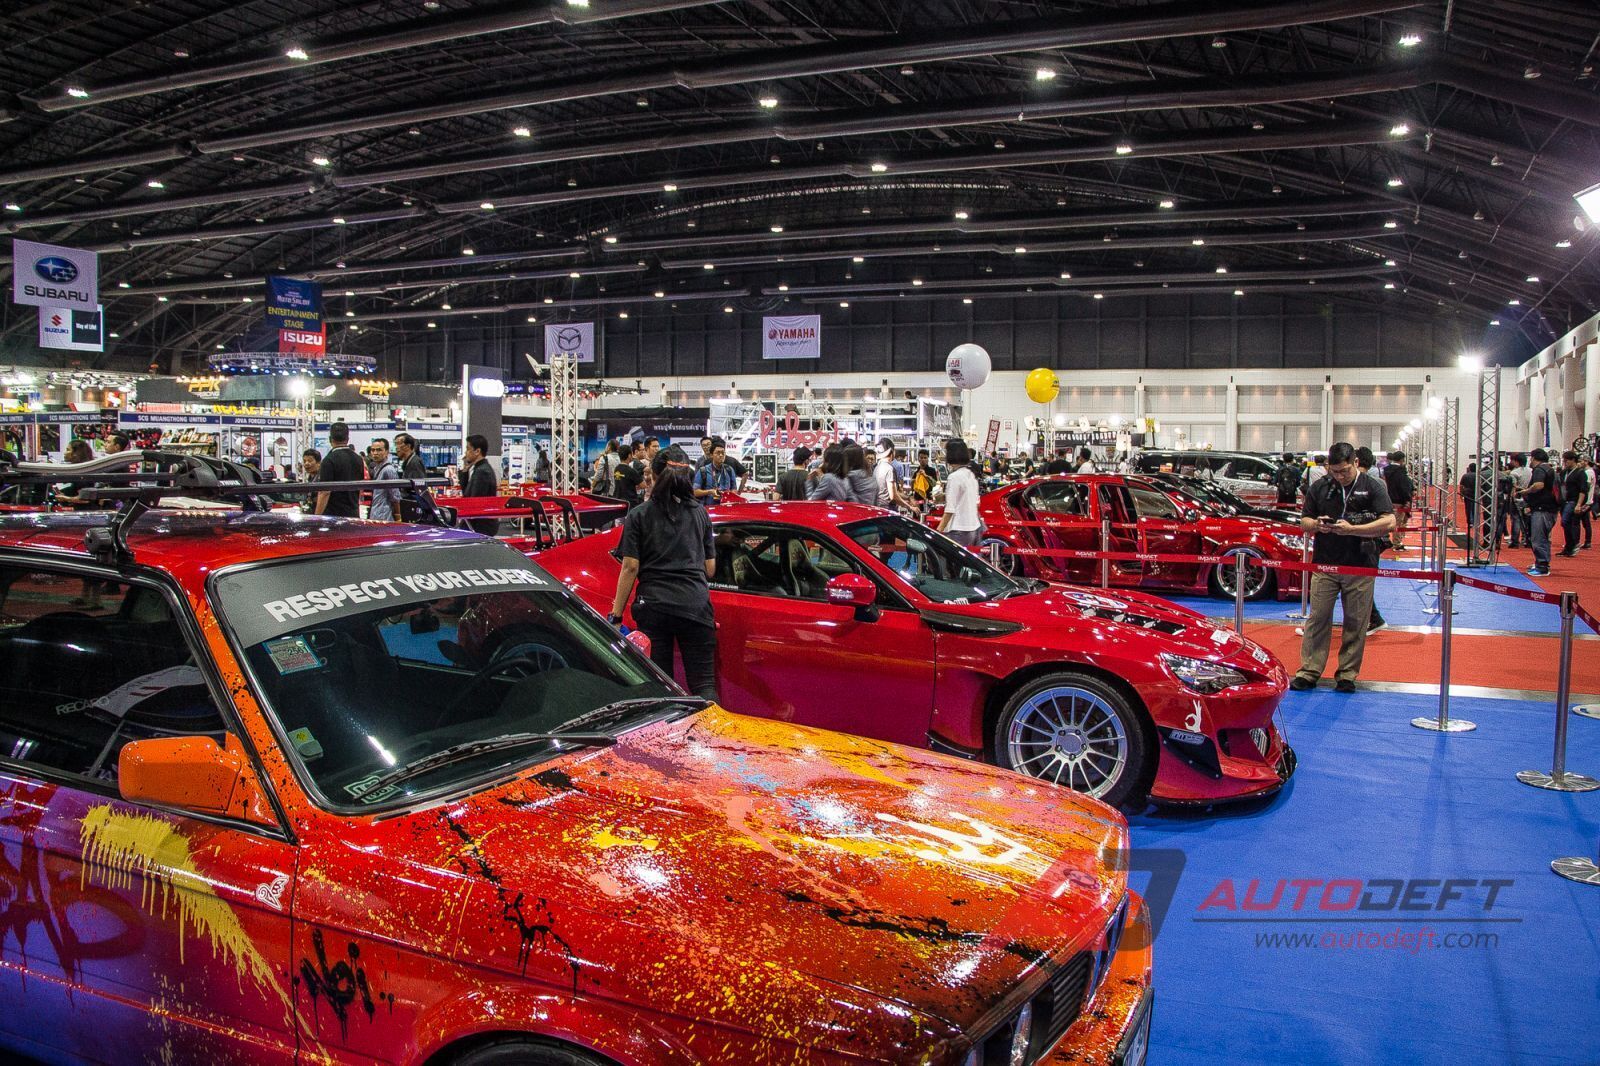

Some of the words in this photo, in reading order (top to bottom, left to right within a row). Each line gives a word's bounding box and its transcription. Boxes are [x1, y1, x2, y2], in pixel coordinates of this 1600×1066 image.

[24, 285, 88, 302] SUBARU
[268, 307, 319, 319] ENTERTAINMENT
[284, 320, 304, 328] STAGE
[284, 332, 322, 345] ISUZU
[779, 328, 815, 339] YAMAHA
[189, 380, 220, 392] PPK
[360, 384, 389, 395] PPK
[263, 579, 400, 622] RESPECT
[394, 571, 471, 593] YOUR
[1530, 592, 1546, 600] IMPACT
